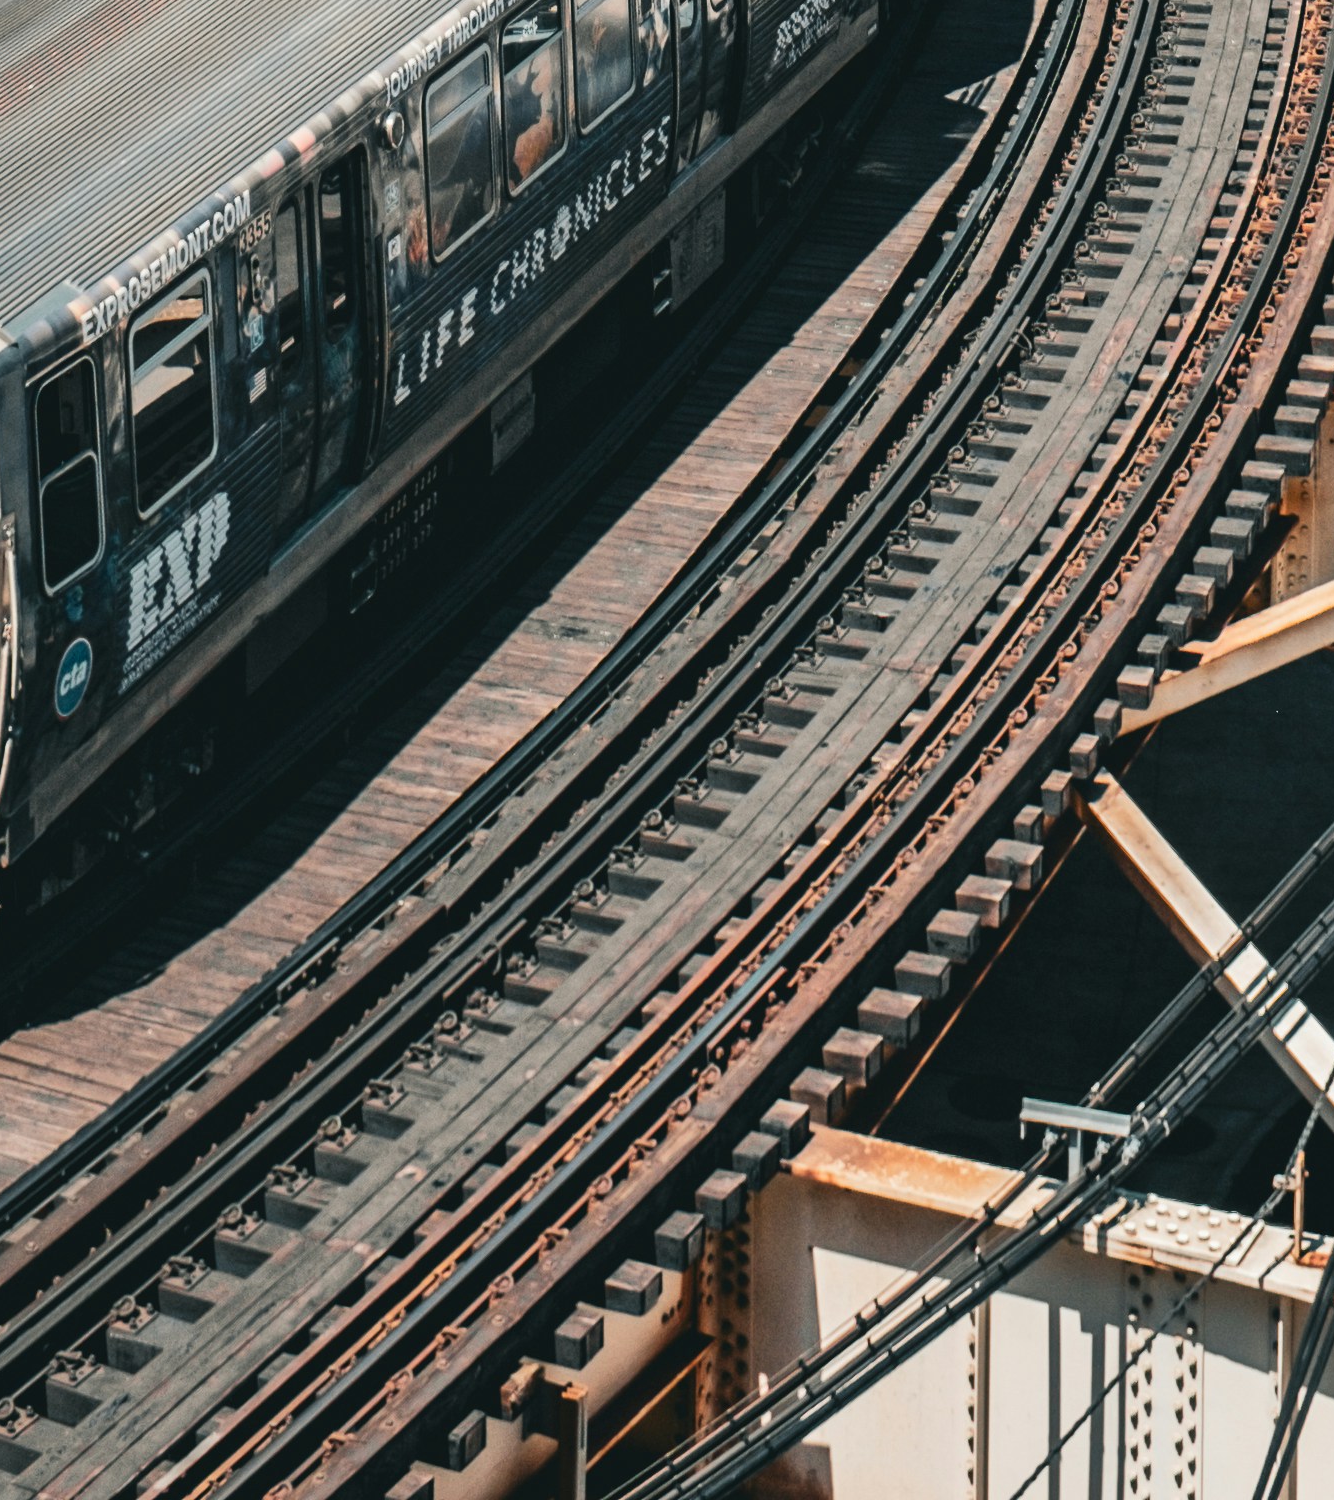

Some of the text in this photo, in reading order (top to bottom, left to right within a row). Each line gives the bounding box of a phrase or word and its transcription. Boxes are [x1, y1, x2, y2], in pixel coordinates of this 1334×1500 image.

[386, 36, 443, 102] JOURNEY
[239, 210, 272, 255] 3355
[394, 115, 671, 406] LIFE CHRONICLES
[80, 188, 251, 344] EXPROSEMONT.COM
[59, 660, 88, 697] cta
